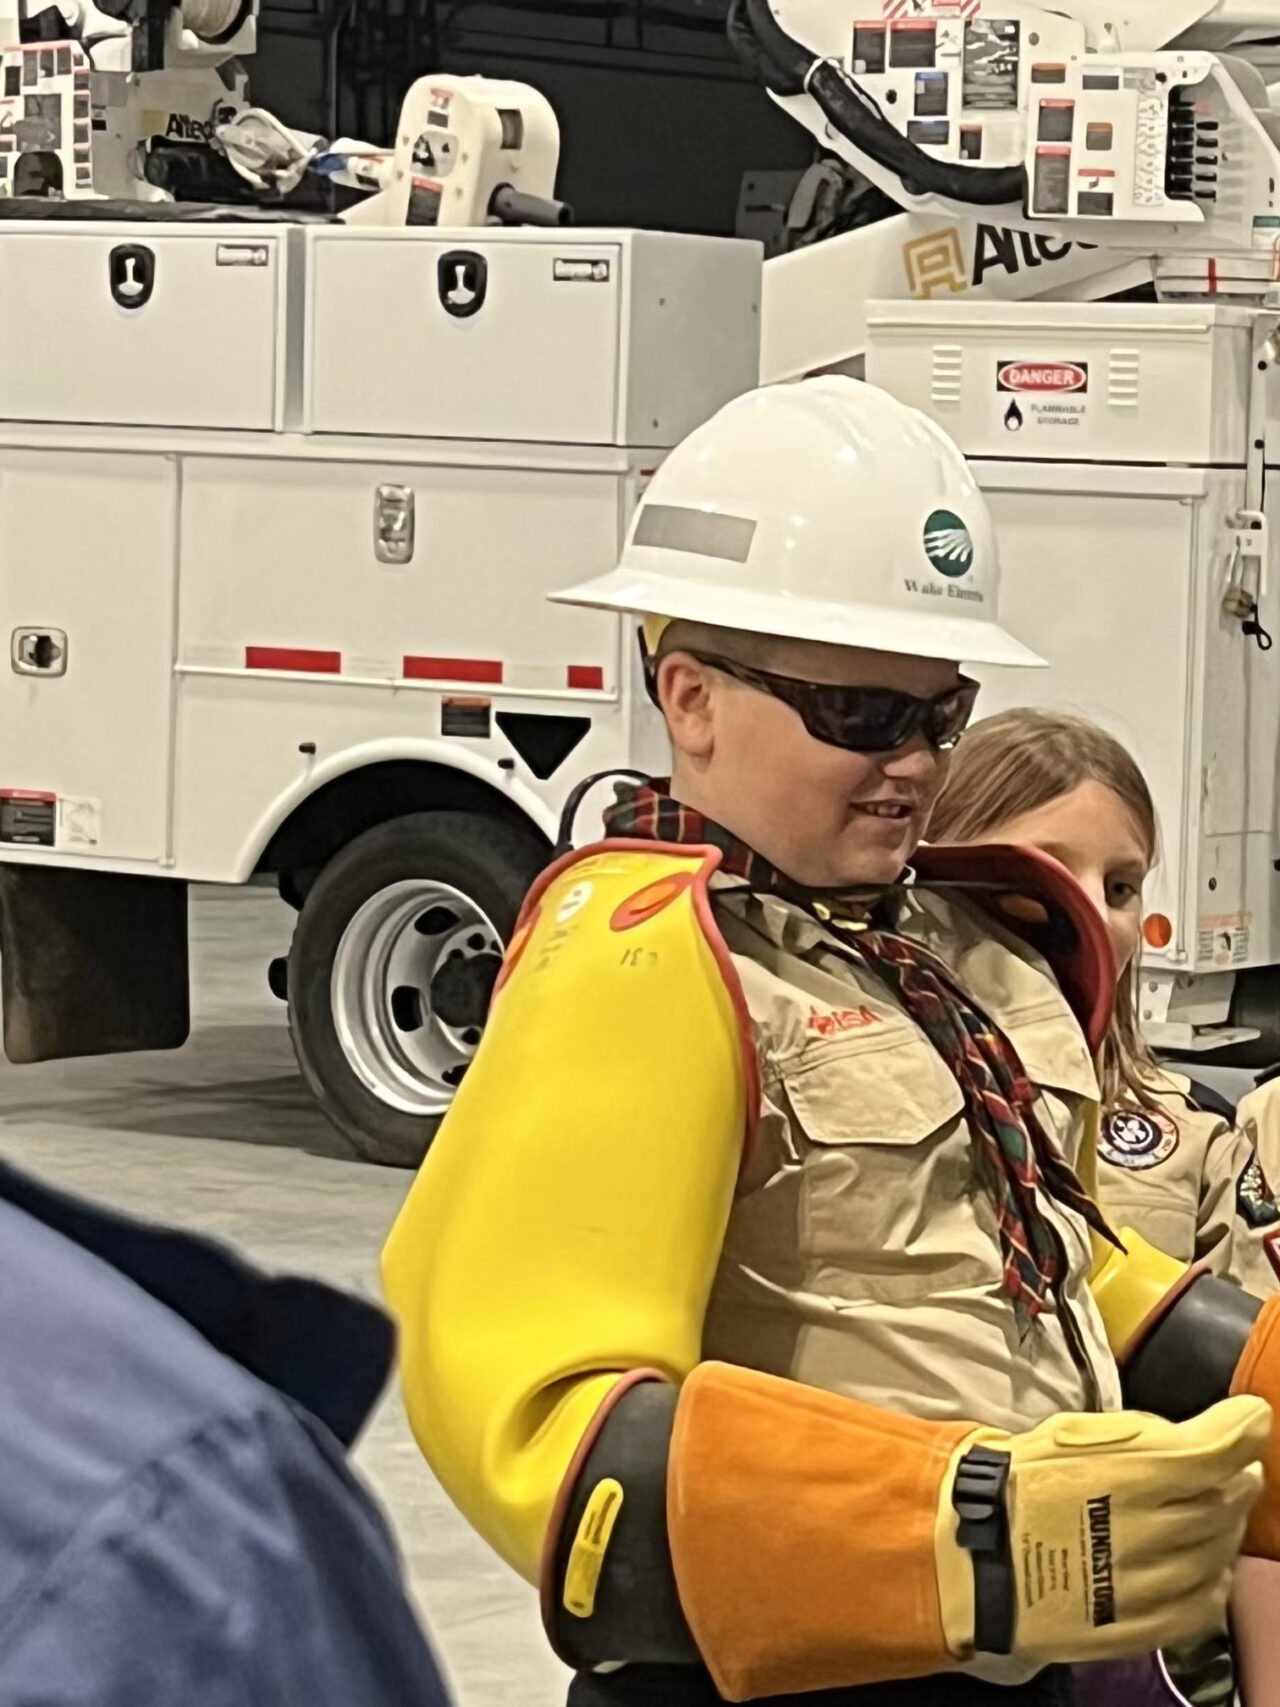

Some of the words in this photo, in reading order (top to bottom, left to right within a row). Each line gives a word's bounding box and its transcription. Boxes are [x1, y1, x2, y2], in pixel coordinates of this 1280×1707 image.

[971, 223, 1099, 286] Alte
[1008, 368, 1076, 386] DANGER
[1086, 1493, 1118, 1628] YOUNGSTOWN
